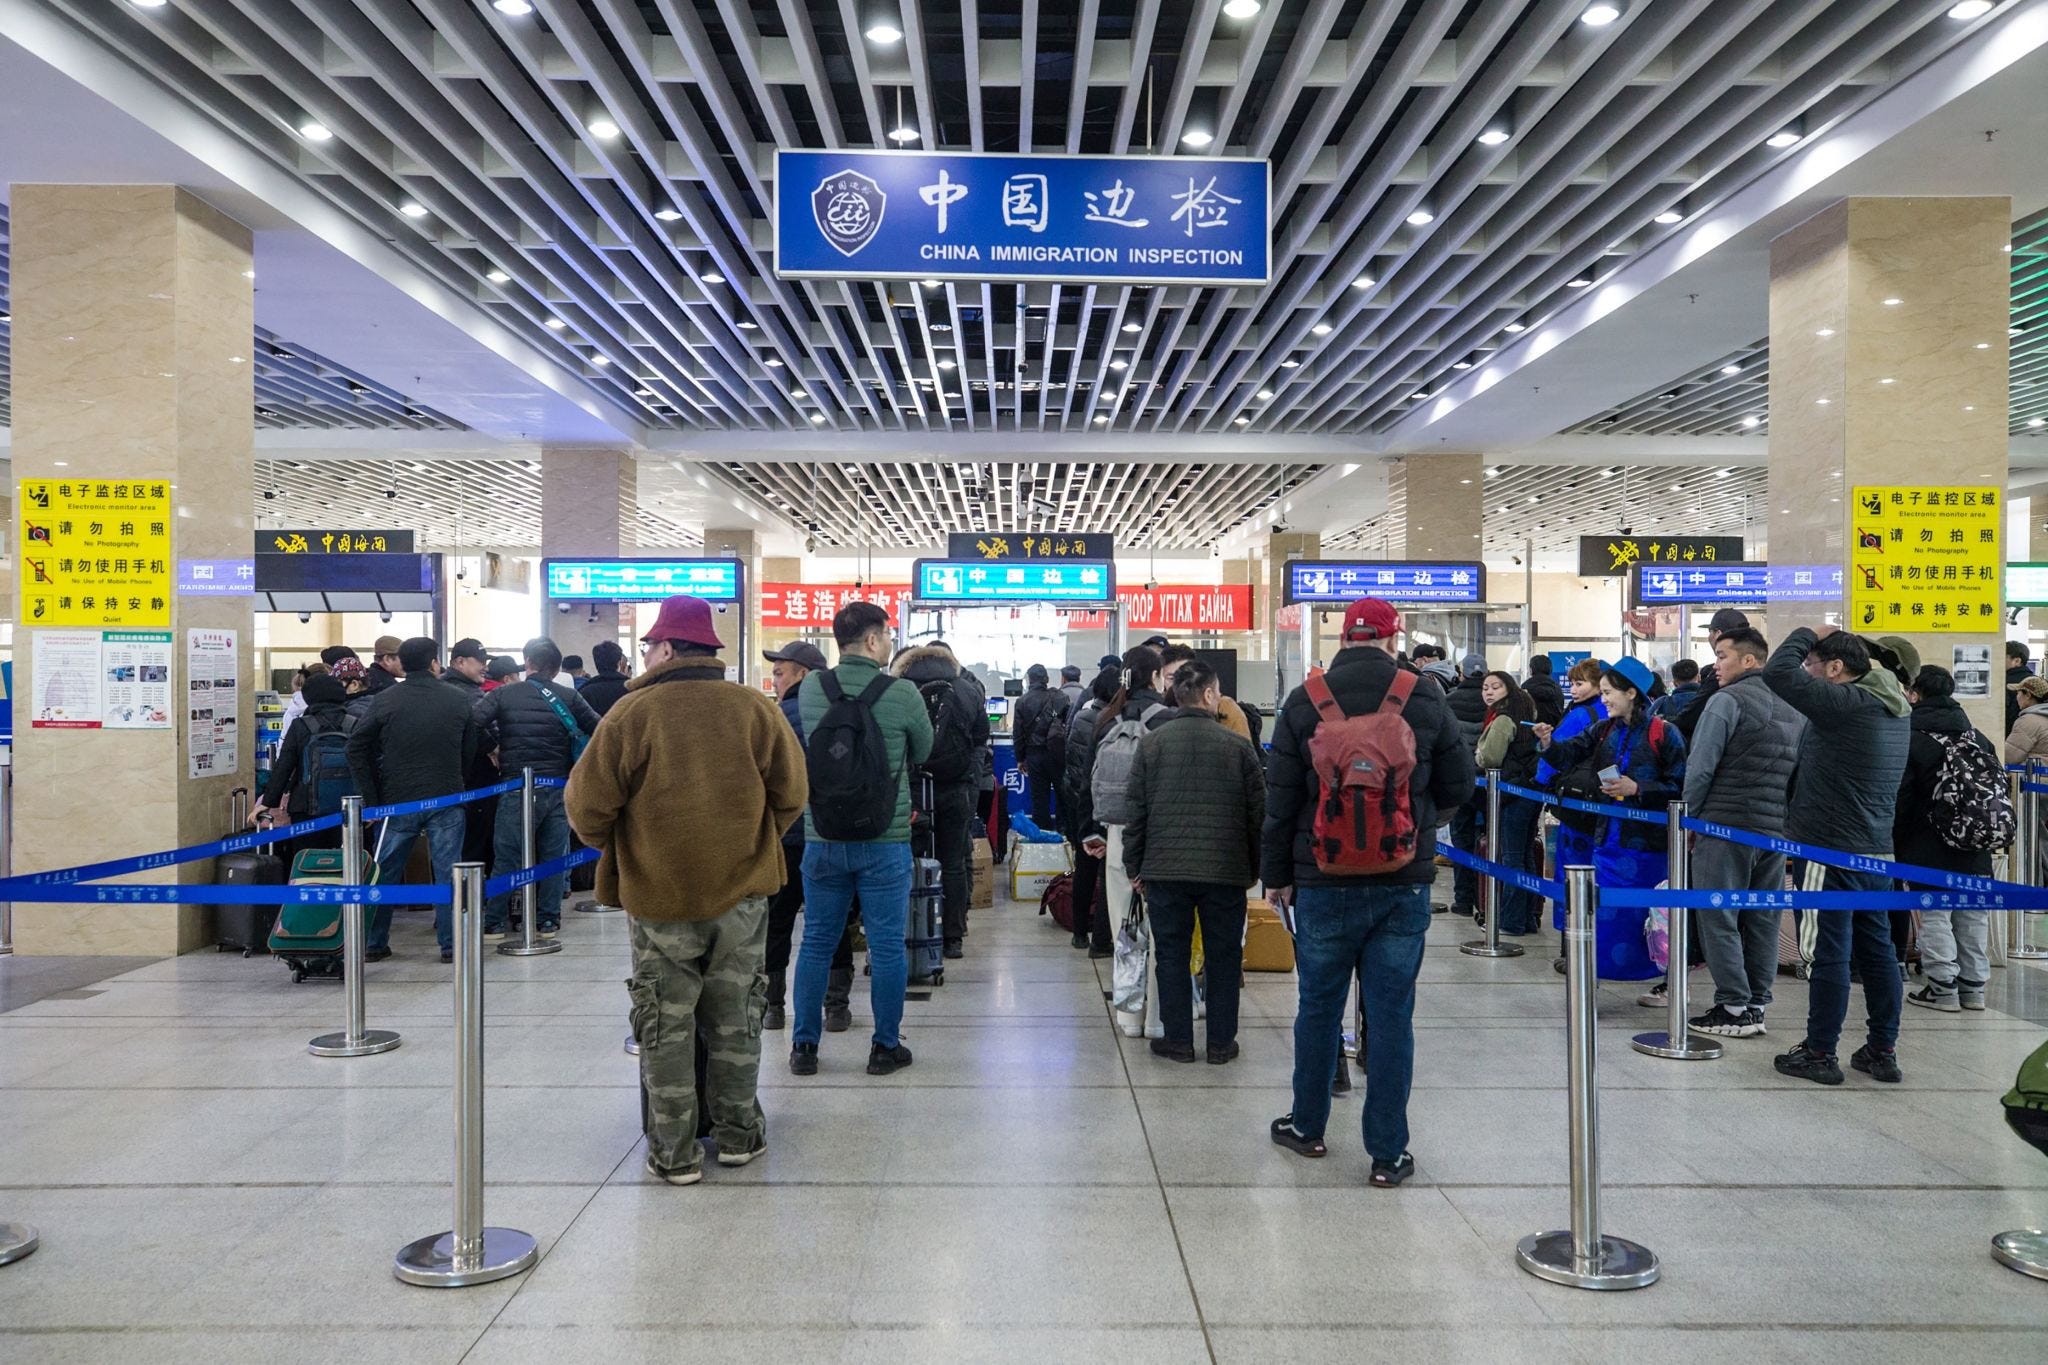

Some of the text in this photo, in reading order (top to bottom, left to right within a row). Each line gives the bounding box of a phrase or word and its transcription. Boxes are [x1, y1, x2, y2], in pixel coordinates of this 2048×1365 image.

[919, 168, 1241, 237] 中国边检
[920, 244, 1243, 265] CHINA IMMIGRATION INSPECTION
[59, 484, 164, 498] 电子监控区域
[1891, 492, 1995, 506] 电子监控区域
[59, 521, 164, 536] 请勿拍照
[1890, 528, 1994, 543] 请勿拍照
[1927, 547, 1969, 555] Photography
[59, 558, 165, 574] 请勿使用手机
[1889, 565, 1994, 580] 请勿使用手机
[1340, 569, 1470, 586] 中国边检
[59, 596, 164, 610] 请保持安静
[1159, 593, 1193, 623] УГТАЖ
[1199, 587, 1235, 623] БАЙНА
[1889, 602, 1993, 616] 请保持安静
[1003, 768, 1025, 794] 国
